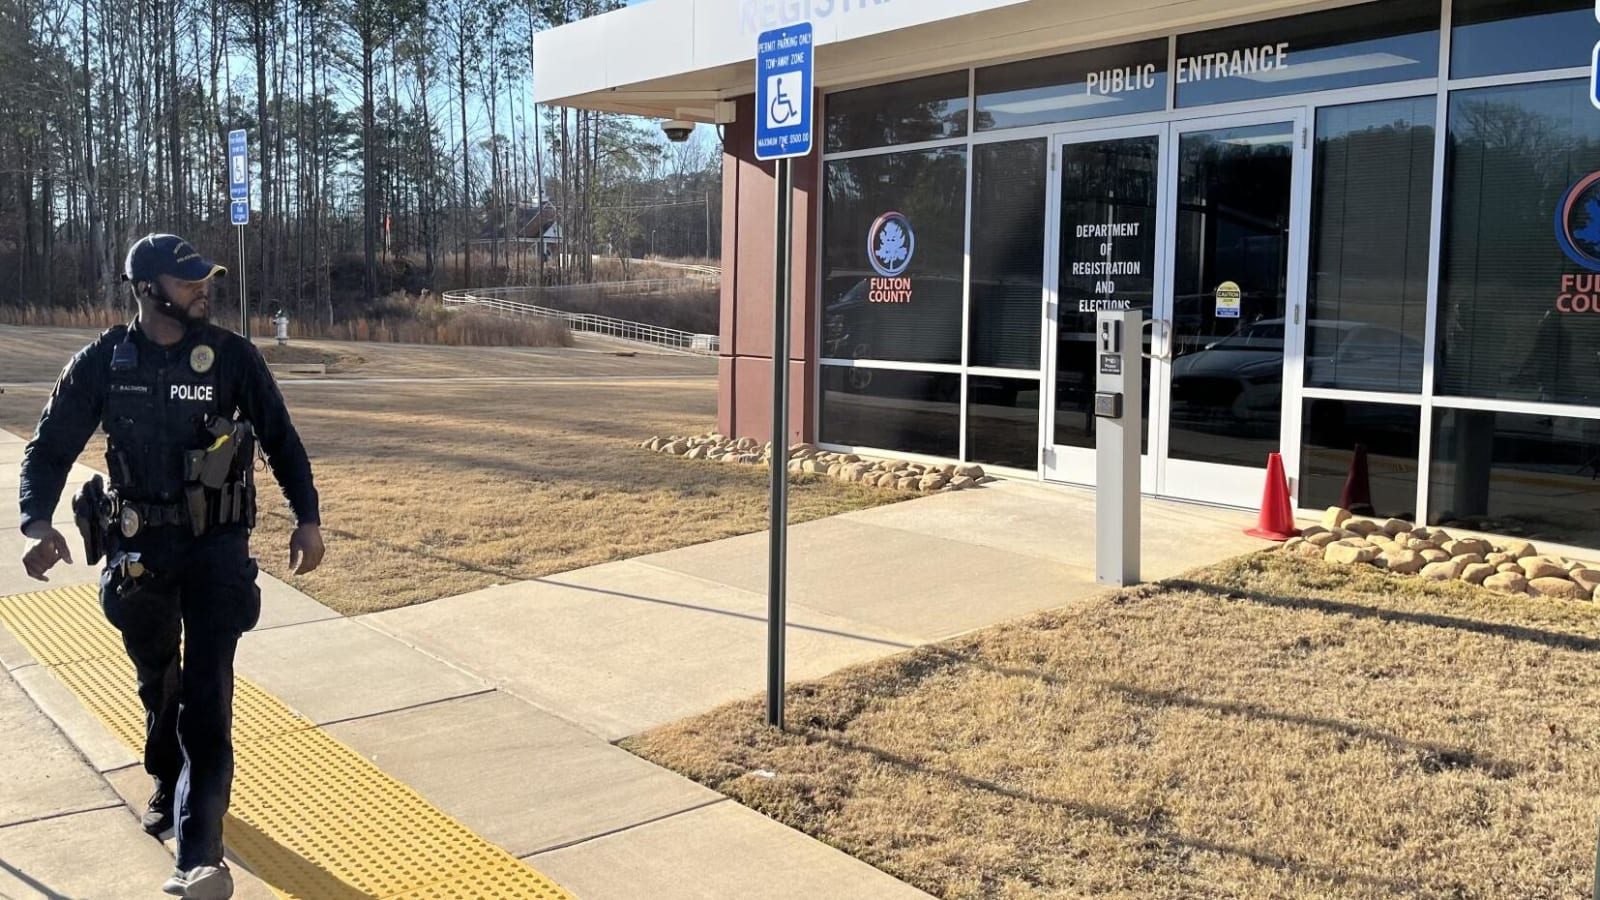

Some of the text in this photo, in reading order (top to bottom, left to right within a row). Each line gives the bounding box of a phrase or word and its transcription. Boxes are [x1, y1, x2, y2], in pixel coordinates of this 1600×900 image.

[759, 33, 811, 53] PERMIT PARKING ONLY
[790, 52, 805, 65] ZONE
[1086, 43, 1289, 96] PUBLIC ENTRANCE
[1076, 223, 1140, 238] DEPARTMENT
[1100, 243, 1113, 256] OF
[1072, 261, 1141, 275] REGISTRATION
[870, 278, 911, 290] FULTON
[1095, 281, 1115, 294] AND
[868, 290, 912, 303] COUNTY
[1079, 300, 1131, 312] ELECTIONS
[170, 385, 213, 401] POLICE
